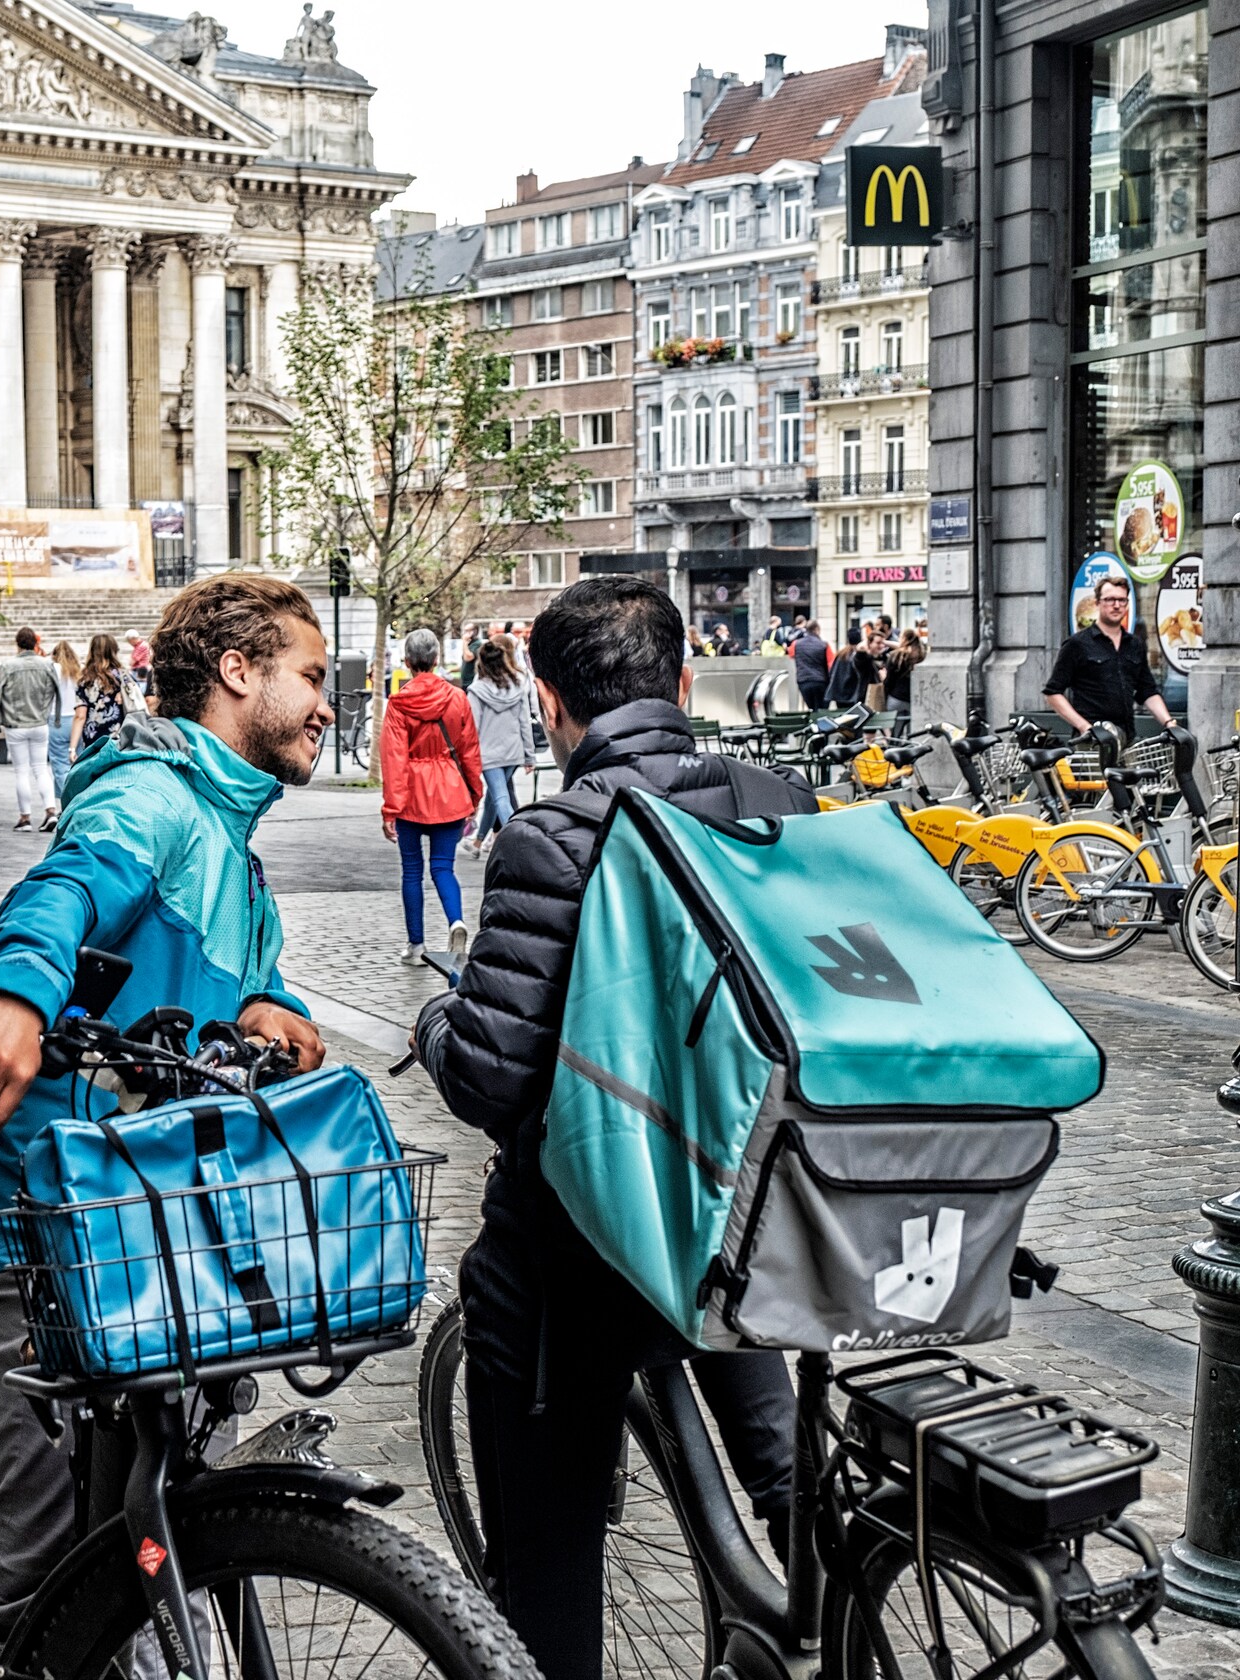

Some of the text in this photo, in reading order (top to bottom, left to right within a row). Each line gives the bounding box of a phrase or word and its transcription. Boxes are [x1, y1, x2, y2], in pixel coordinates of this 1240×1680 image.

[847, 568, 866, 583] ICI
[869, 566, 906, 582] PARIS
[908, 565, 926, 581] XL
[832, 1329, 966, 1351] deliveroo
[157, 1598, 191, 1668] VICTORIA
